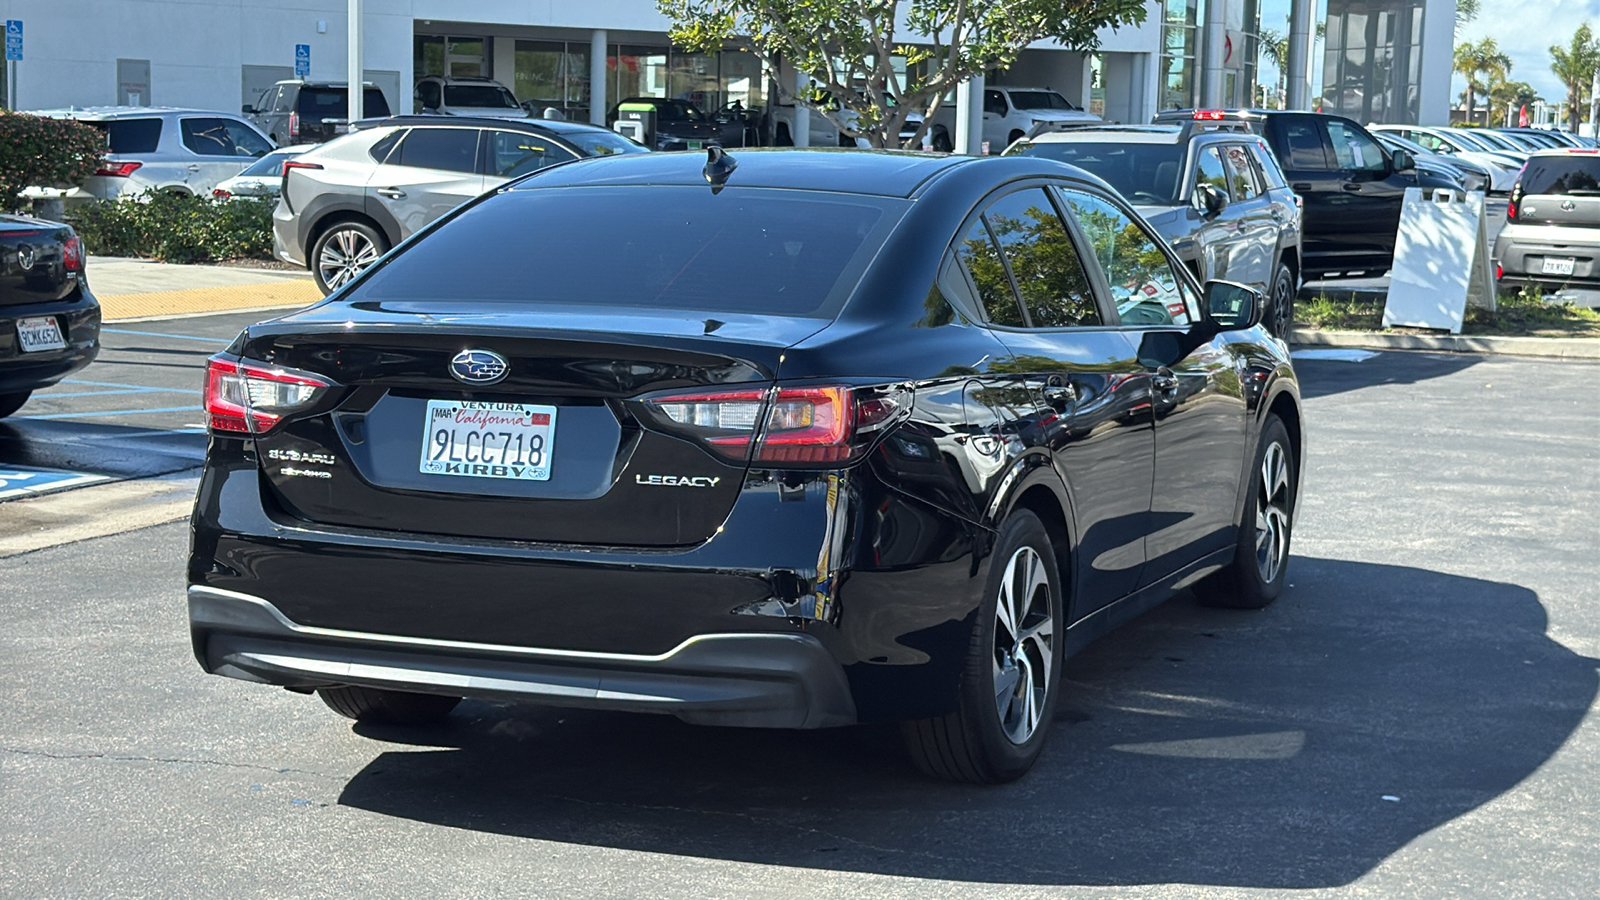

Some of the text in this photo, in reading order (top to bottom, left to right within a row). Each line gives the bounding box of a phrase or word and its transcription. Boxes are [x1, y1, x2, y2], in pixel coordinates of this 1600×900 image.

[21, 328, 59, 347] 9CMK652
[435, 409, 452, 419] MAR
[460, 401, 525, 412] VENTURA
[455, 409, 532, 430] California
[432, 428, 544, 467] 9LCC718
[268, 449, 335, 465] SUBARU
[445, 462, 526, 477] KIRBY
[635, 474, 720, 487] LEGACY
